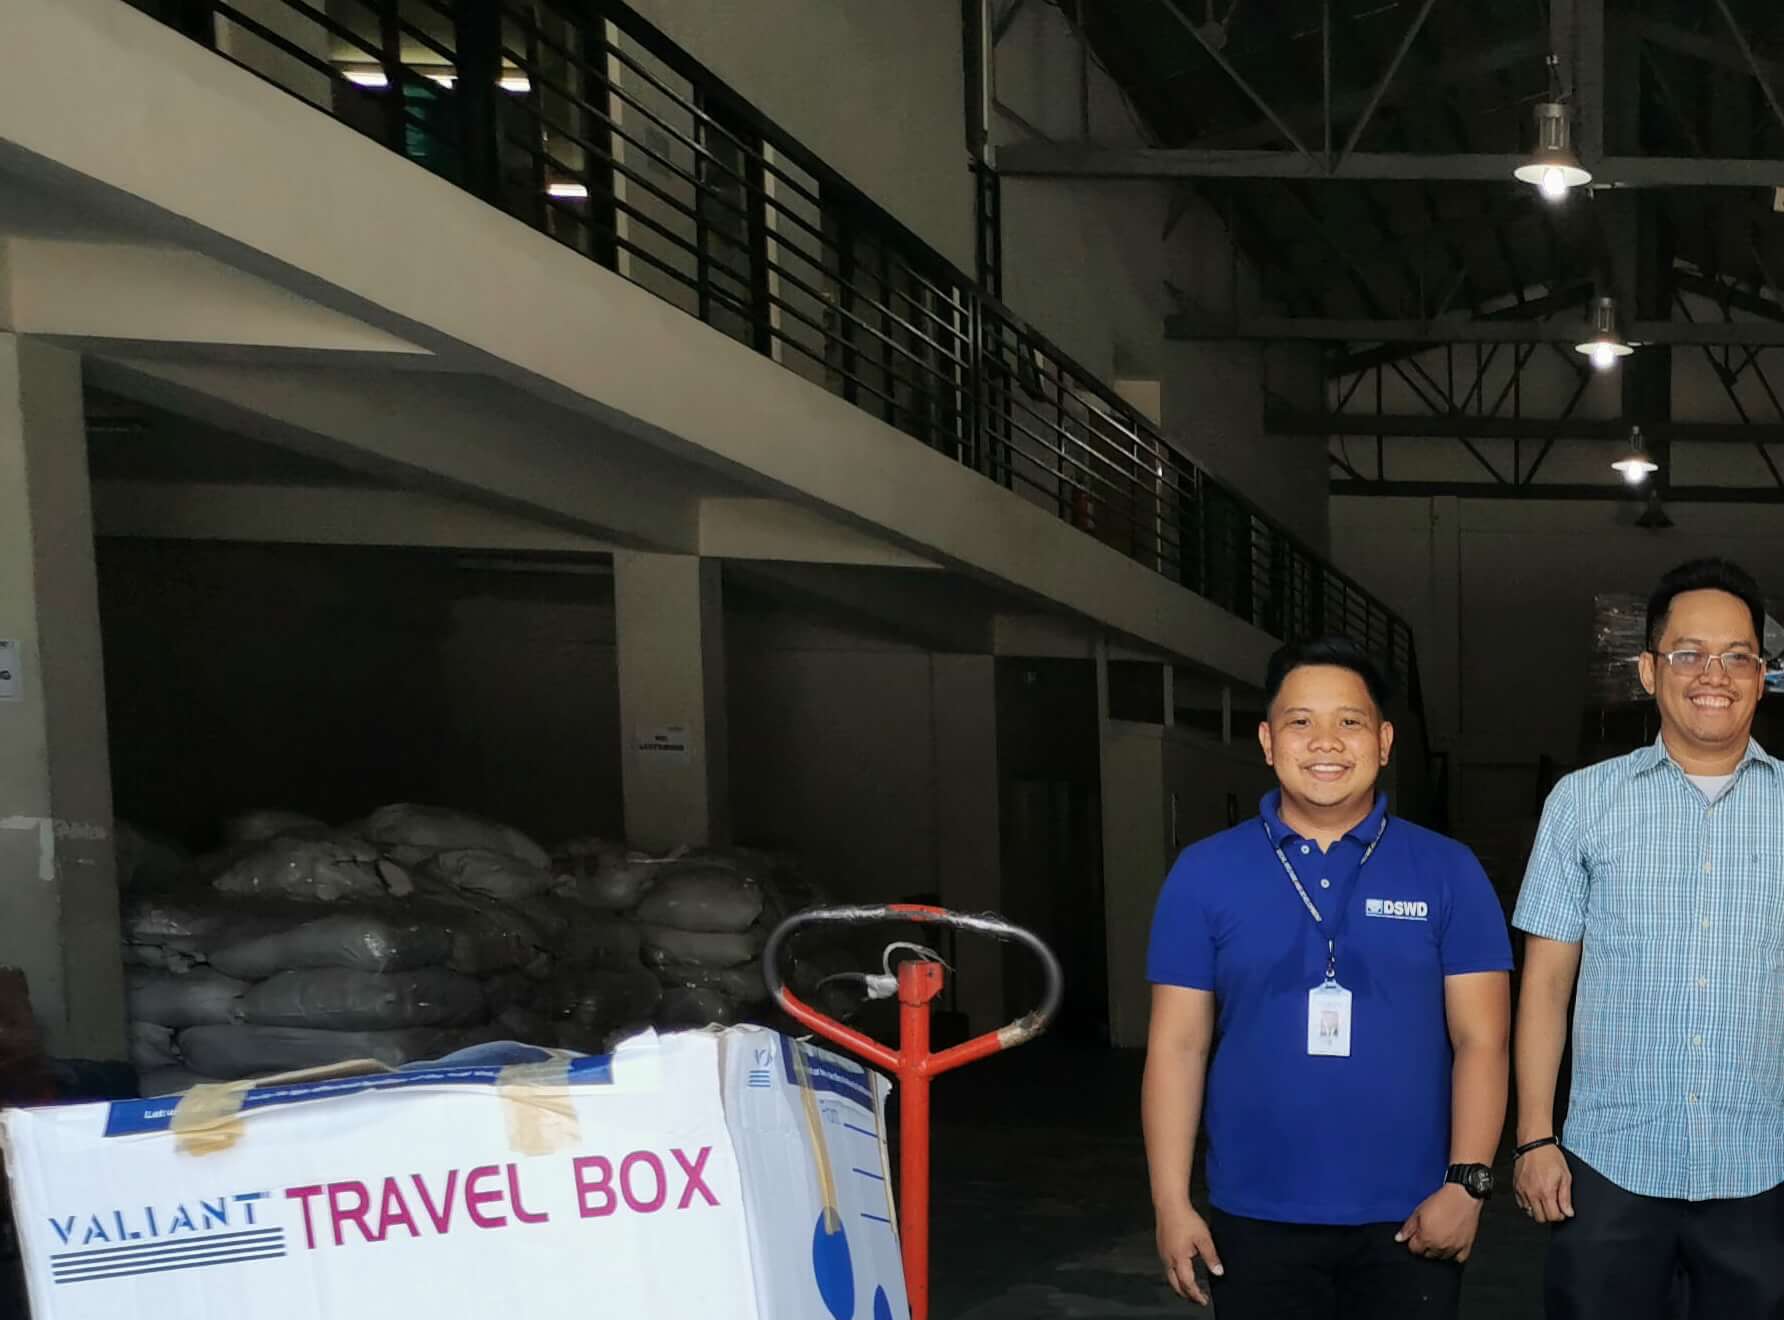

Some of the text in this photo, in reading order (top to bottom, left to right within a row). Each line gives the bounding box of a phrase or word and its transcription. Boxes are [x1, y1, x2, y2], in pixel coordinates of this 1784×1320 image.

[1383, 899, 1428, 918] DSWD
[49, 1145, 721, 1250] VALIANT TRAVEL BOX
